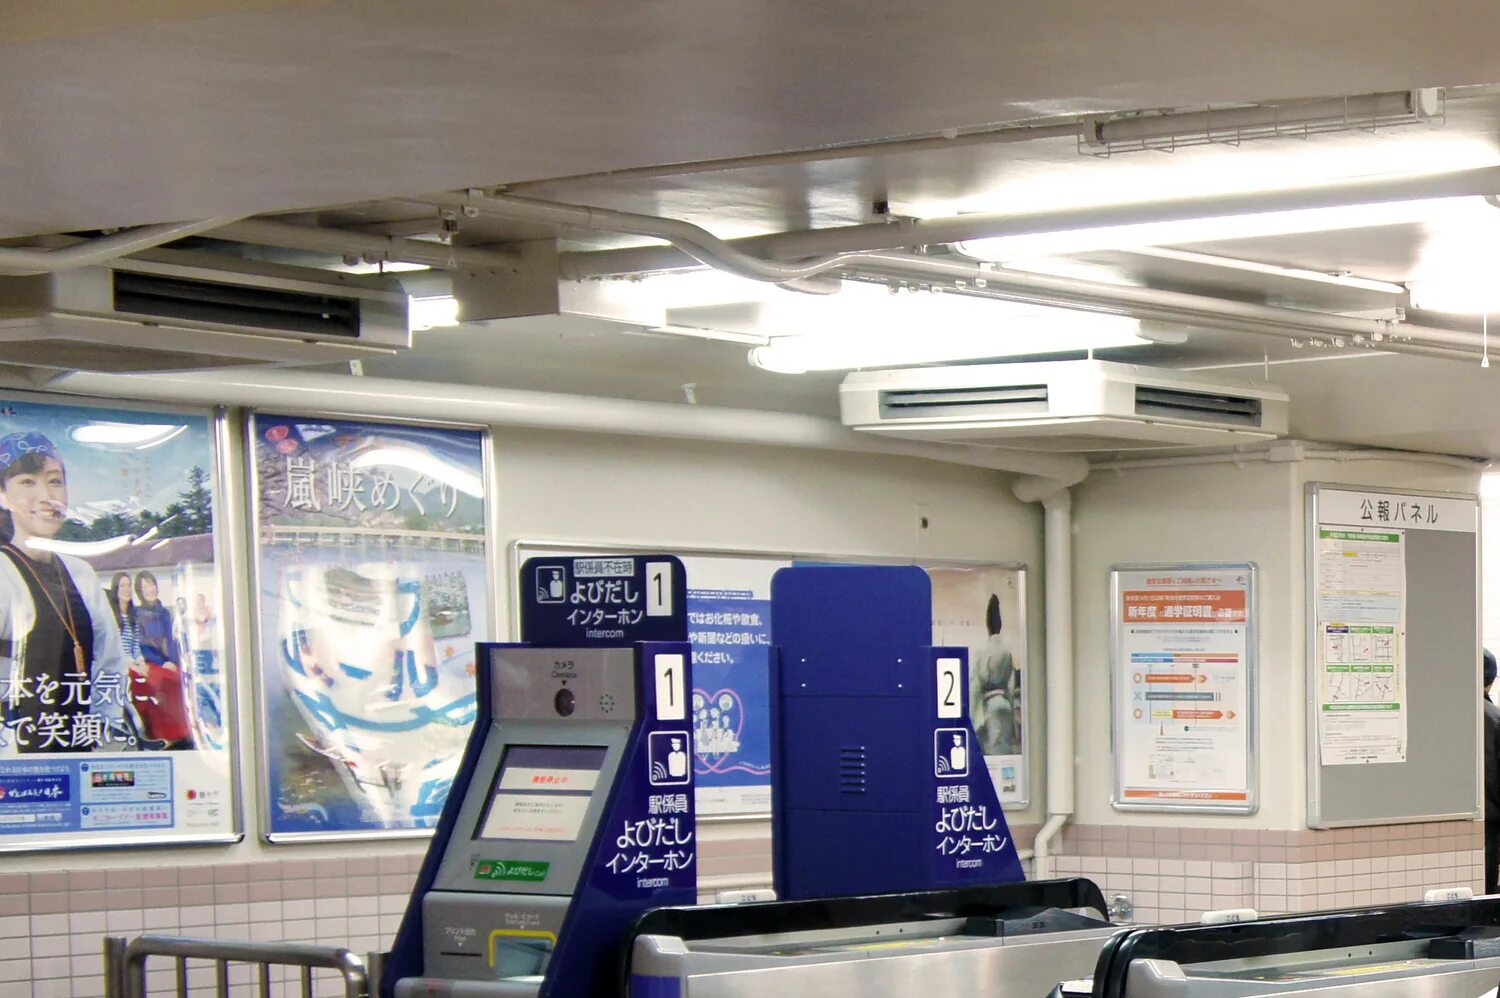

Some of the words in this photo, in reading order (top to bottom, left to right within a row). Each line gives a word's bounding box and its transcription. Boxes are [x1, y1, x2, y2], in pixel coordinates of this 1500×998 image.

[283, 456, 457, 518] 嵐峡めぐり
[1360, 499, 1439, 524] 公報パネル
[575, 560, 632, 575] 駅係員不在時
[570, 580, 639, 604] よびだし
[653, 572, 662, 606] 1
[566, 608, 643, 626] インターホン
[585, 628, 624, 638] intercom
[553, 661, 575, 670] カメラ
[0, 672, 159, 706] 本を元気に、
[664, 667, 674, 707] 1
[943, 670, 955, 706] 2
[648, 794, 688, 814] 駅係員
[937, 785, 970, 804] 駅係員
[936, 805, 997, 833] よびだし
[616, 817, 692, 848] よびだし
[936, 833, 1007, 856] インターホン
[506, 866, 534, 877] よびだし
[605, 850, 693, 875] インターホン
[956, 857, 983, 869] intercom
[636, 877, 669, 888] intercom
